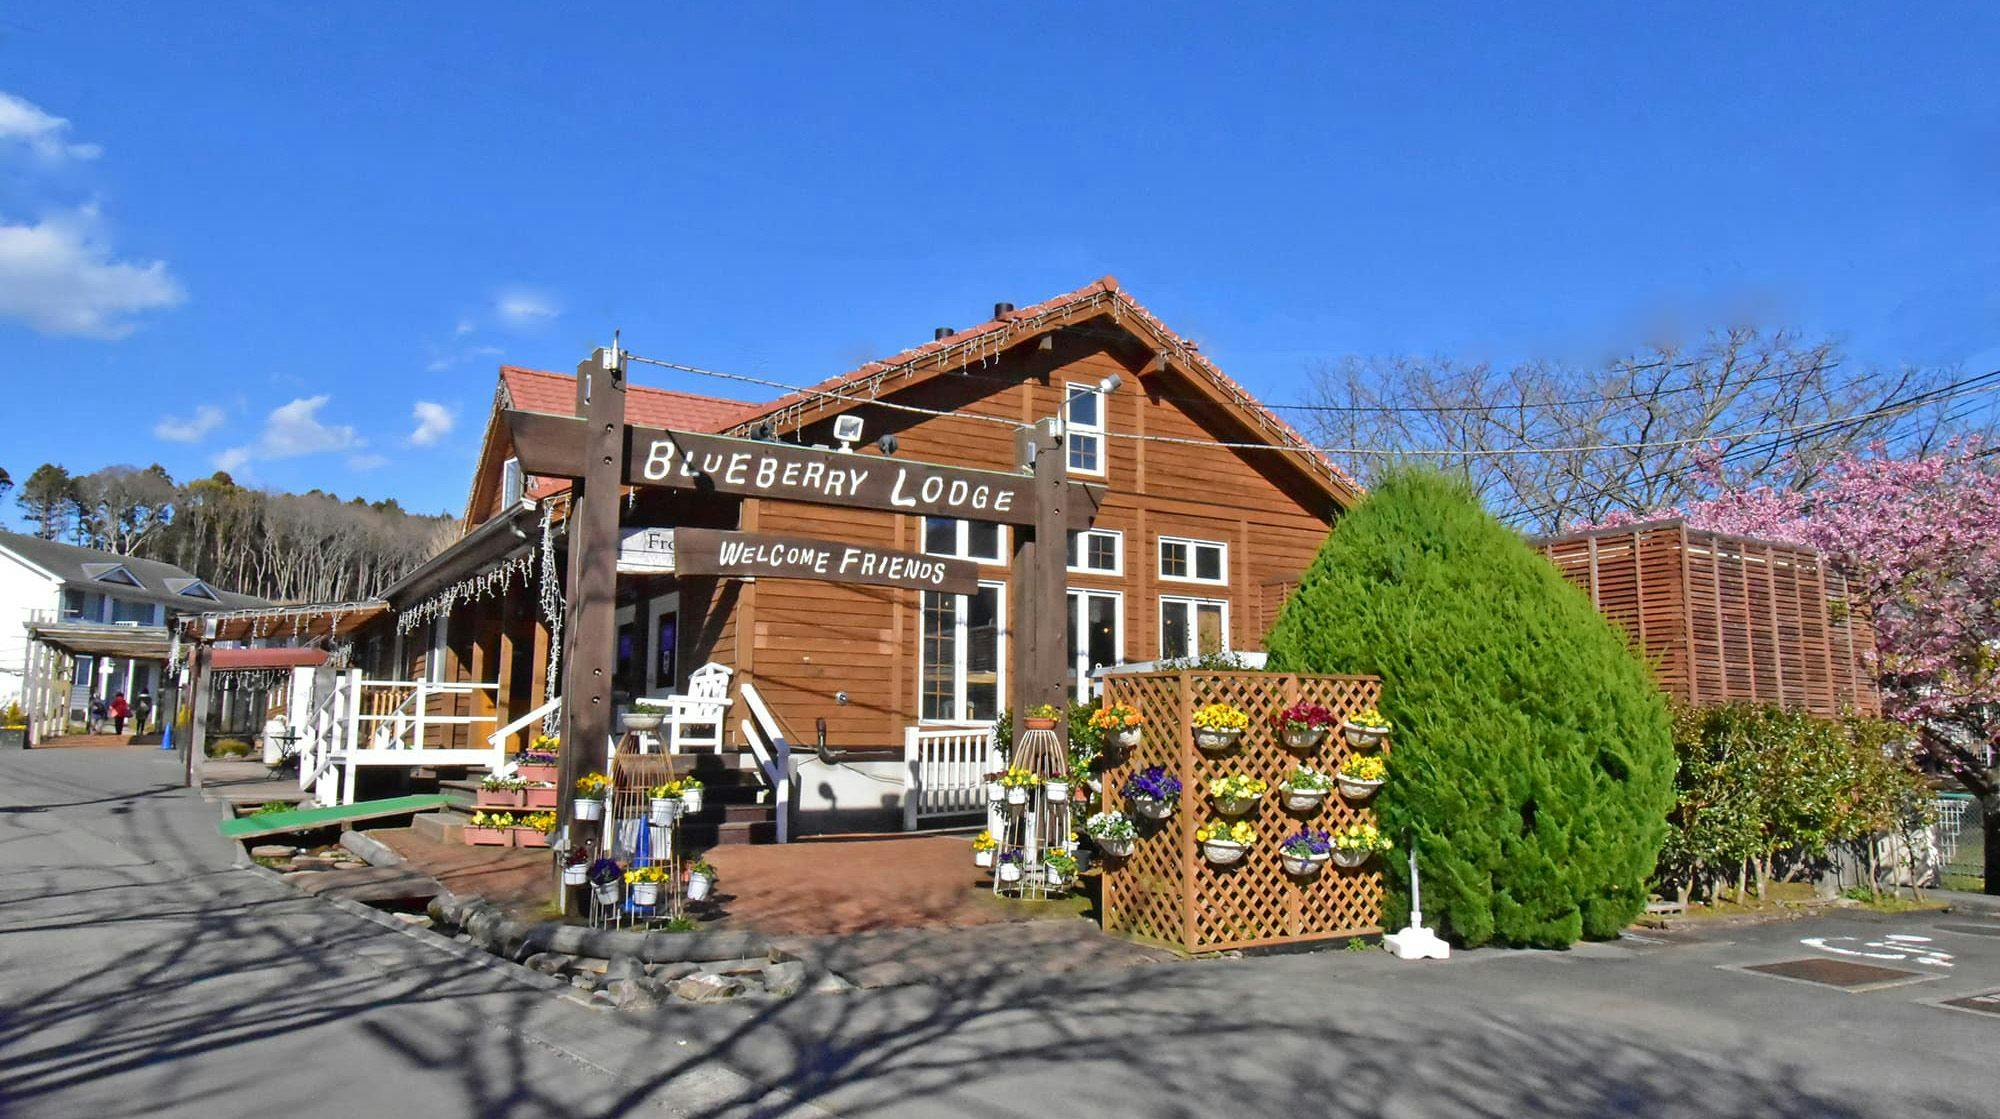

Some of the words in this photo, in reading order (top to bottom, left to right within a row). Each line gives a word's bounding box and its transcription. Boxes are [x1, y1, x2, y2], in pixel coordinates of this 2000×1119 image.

[644, 440, 869, 496] BLUEBERRY
[890, 468, 1015, 512] LODGE
[719, 541, 830, 573] WELCOME
[839, 548, 946, 584] FRIENDS
